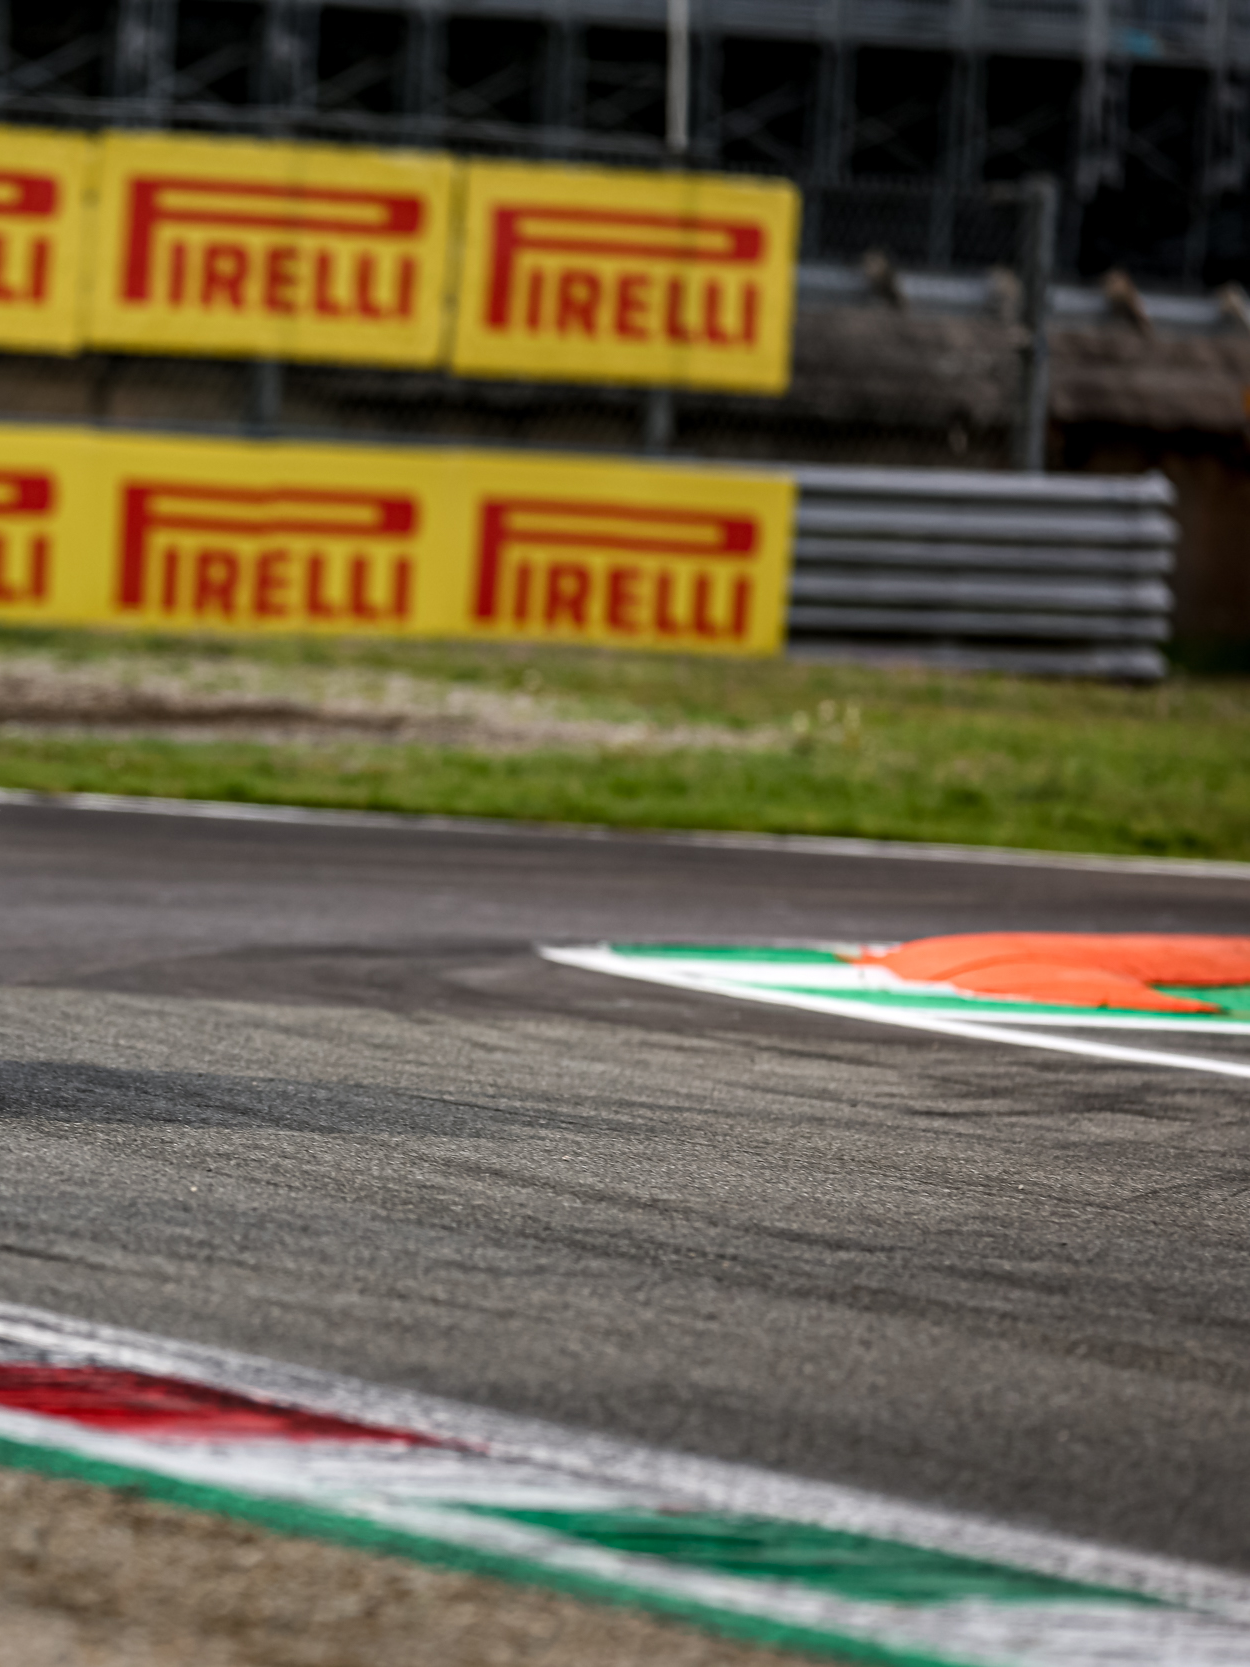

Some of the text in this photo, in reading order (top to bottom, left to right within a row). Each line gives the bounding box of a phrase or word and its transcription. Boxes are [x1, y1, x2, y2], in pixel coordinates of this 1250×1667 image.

[120, 176, 425, 320] PIRELLI
[484, 206, 766, 346] PIRELLI
[117, 481, 419, 620] PIRELLI
[472, 499, 760, 639] PIRELLI
